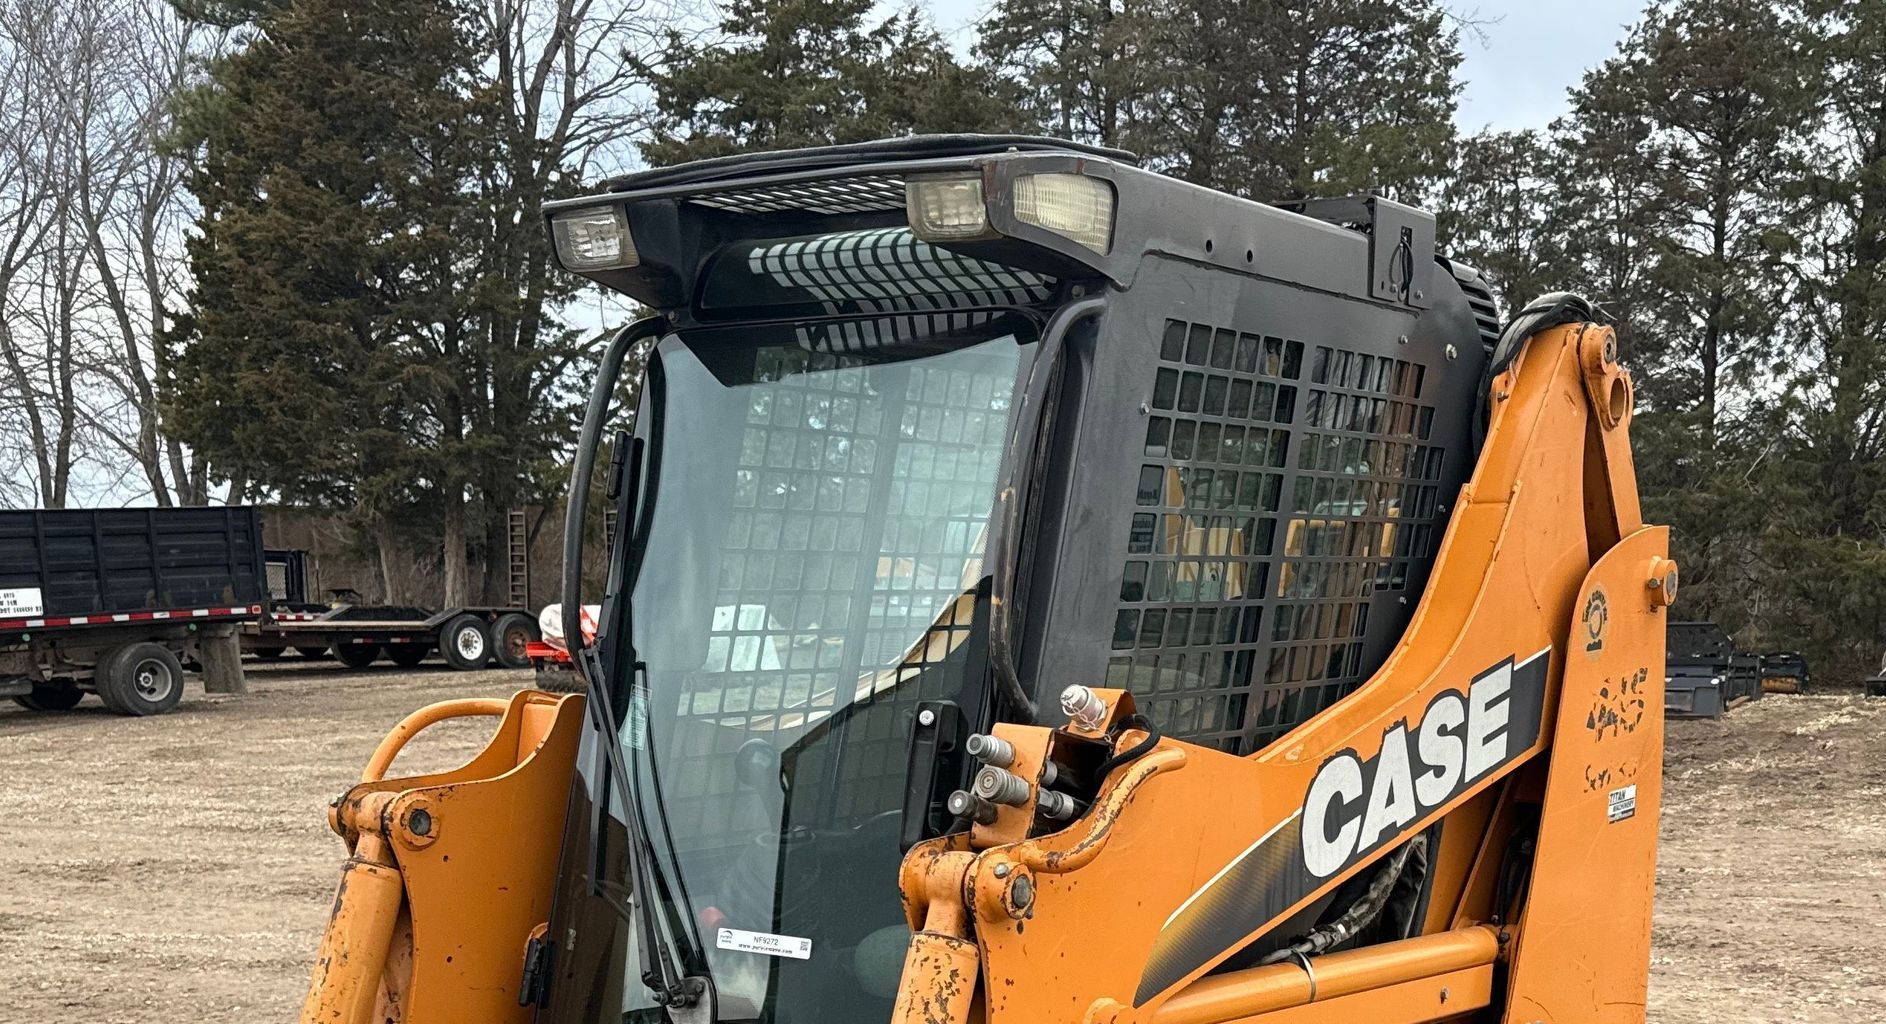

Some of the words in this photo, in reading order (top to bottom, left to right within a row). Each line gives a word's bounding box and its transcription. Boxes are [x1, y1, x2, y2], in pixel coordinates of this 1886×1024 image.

[1301, 660, 1513, 878] CASE
[1609, 789, 1626, 804] TITAN
[753, 935, 779, 946] NF9272
